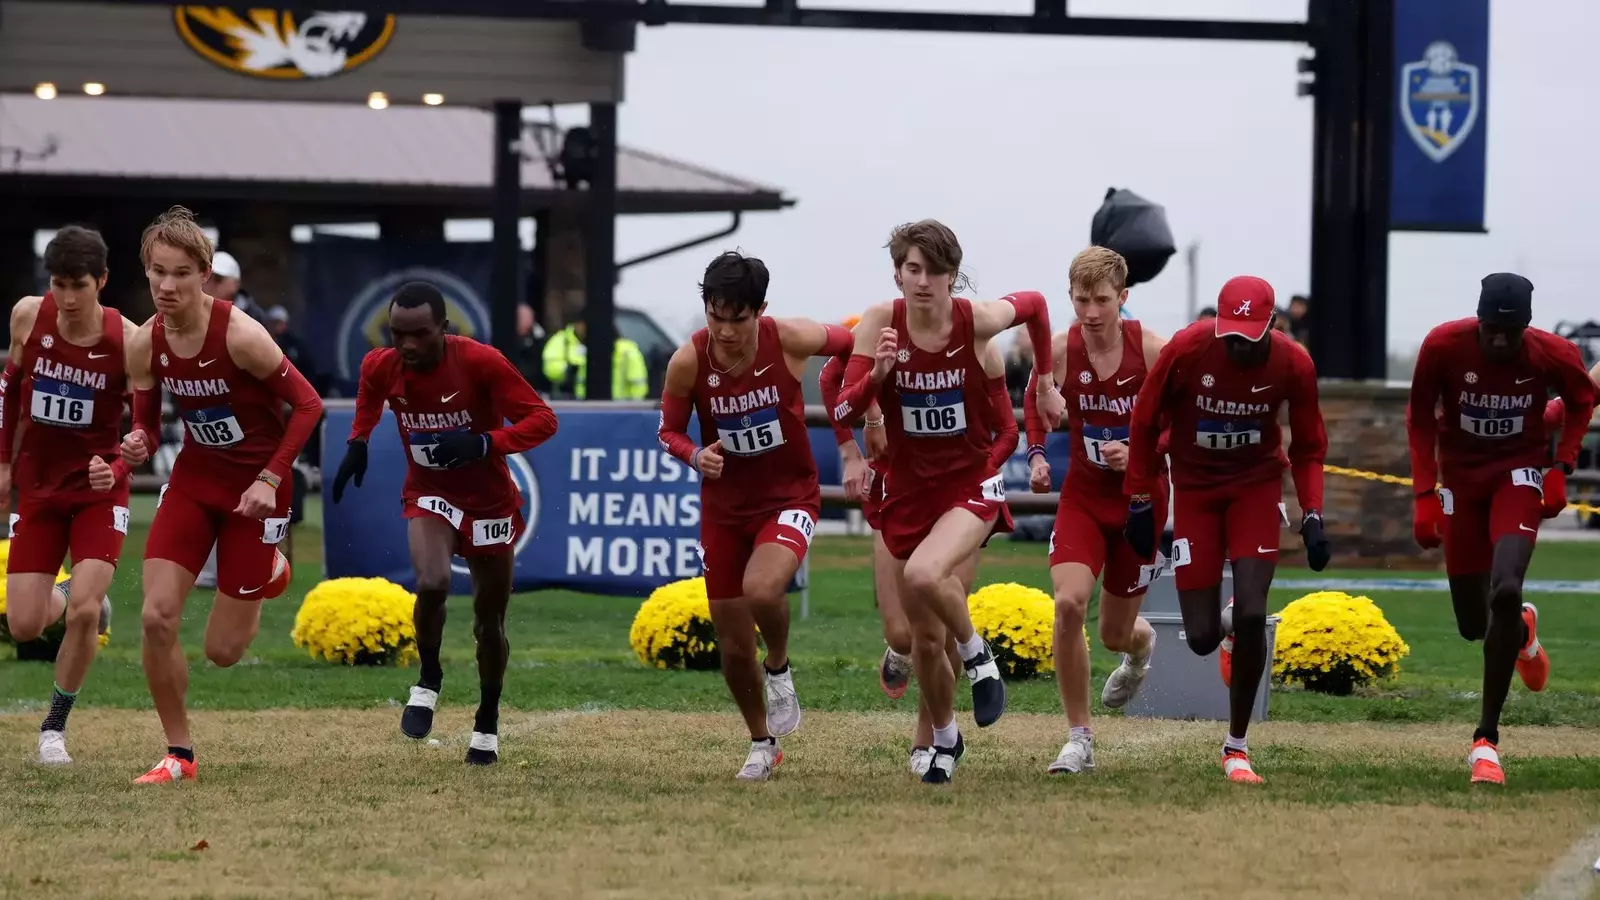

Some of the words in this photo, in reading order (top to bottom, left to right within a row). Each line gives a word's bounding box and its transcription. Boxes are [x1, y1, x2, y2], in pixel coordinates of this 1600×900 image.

[33, 356, 106, 390] ALABAMA
[161, 376, 230, 396] ALABAMA
[42, 395, 84, 422] 116
[710, 385, 779, 414] ALABAMA
[1196, 394, 1269, 415] ALABAMA
[1460, 390, 1532, 410] ALABAMA
[401, 409, 472, 428] ALABAMA
[911, 407, 956, 431] 106
[1470, 419, 1513, 435] 109
[192, 421, 234, 443] 103
[728, 424, 773, 451] 115
[1207, 432, 1251, 448] 110
[570, 448, 607, 481] IT
[429, 499, 453, 519] 104
[568, 492, 701, 527] MEANS
[483, 522, 509, 540] 104
[792, 513, 812, 536] 115
[566, 536, 699, 577] MORE
